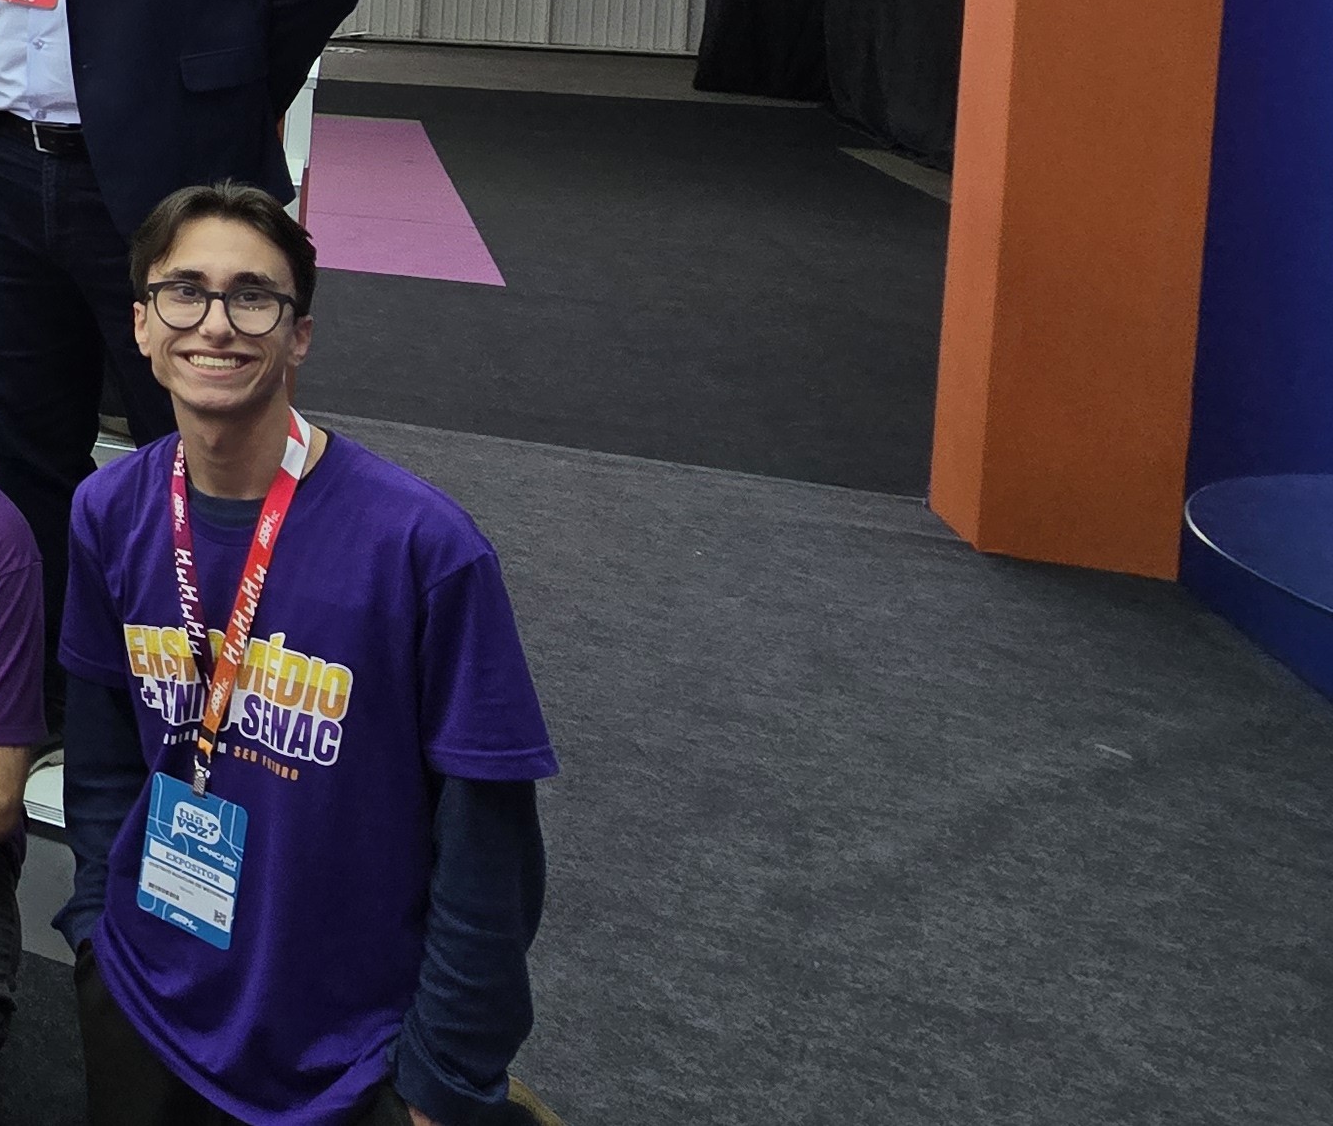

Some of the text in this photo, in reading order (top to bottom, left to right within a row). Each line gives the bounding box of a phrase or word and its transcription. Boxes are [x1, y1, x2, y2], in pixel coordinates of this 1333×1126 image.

[124, 624, 226, 685] ENSIO
[232, 632, 353, 721] MÉDIO
[239, 693, 342, 765] SENAC
[234, 745, 258, 763] SEU
[179, 808, 204, 824] tua
[165, 850, 221, 884] EXPOSITOR
